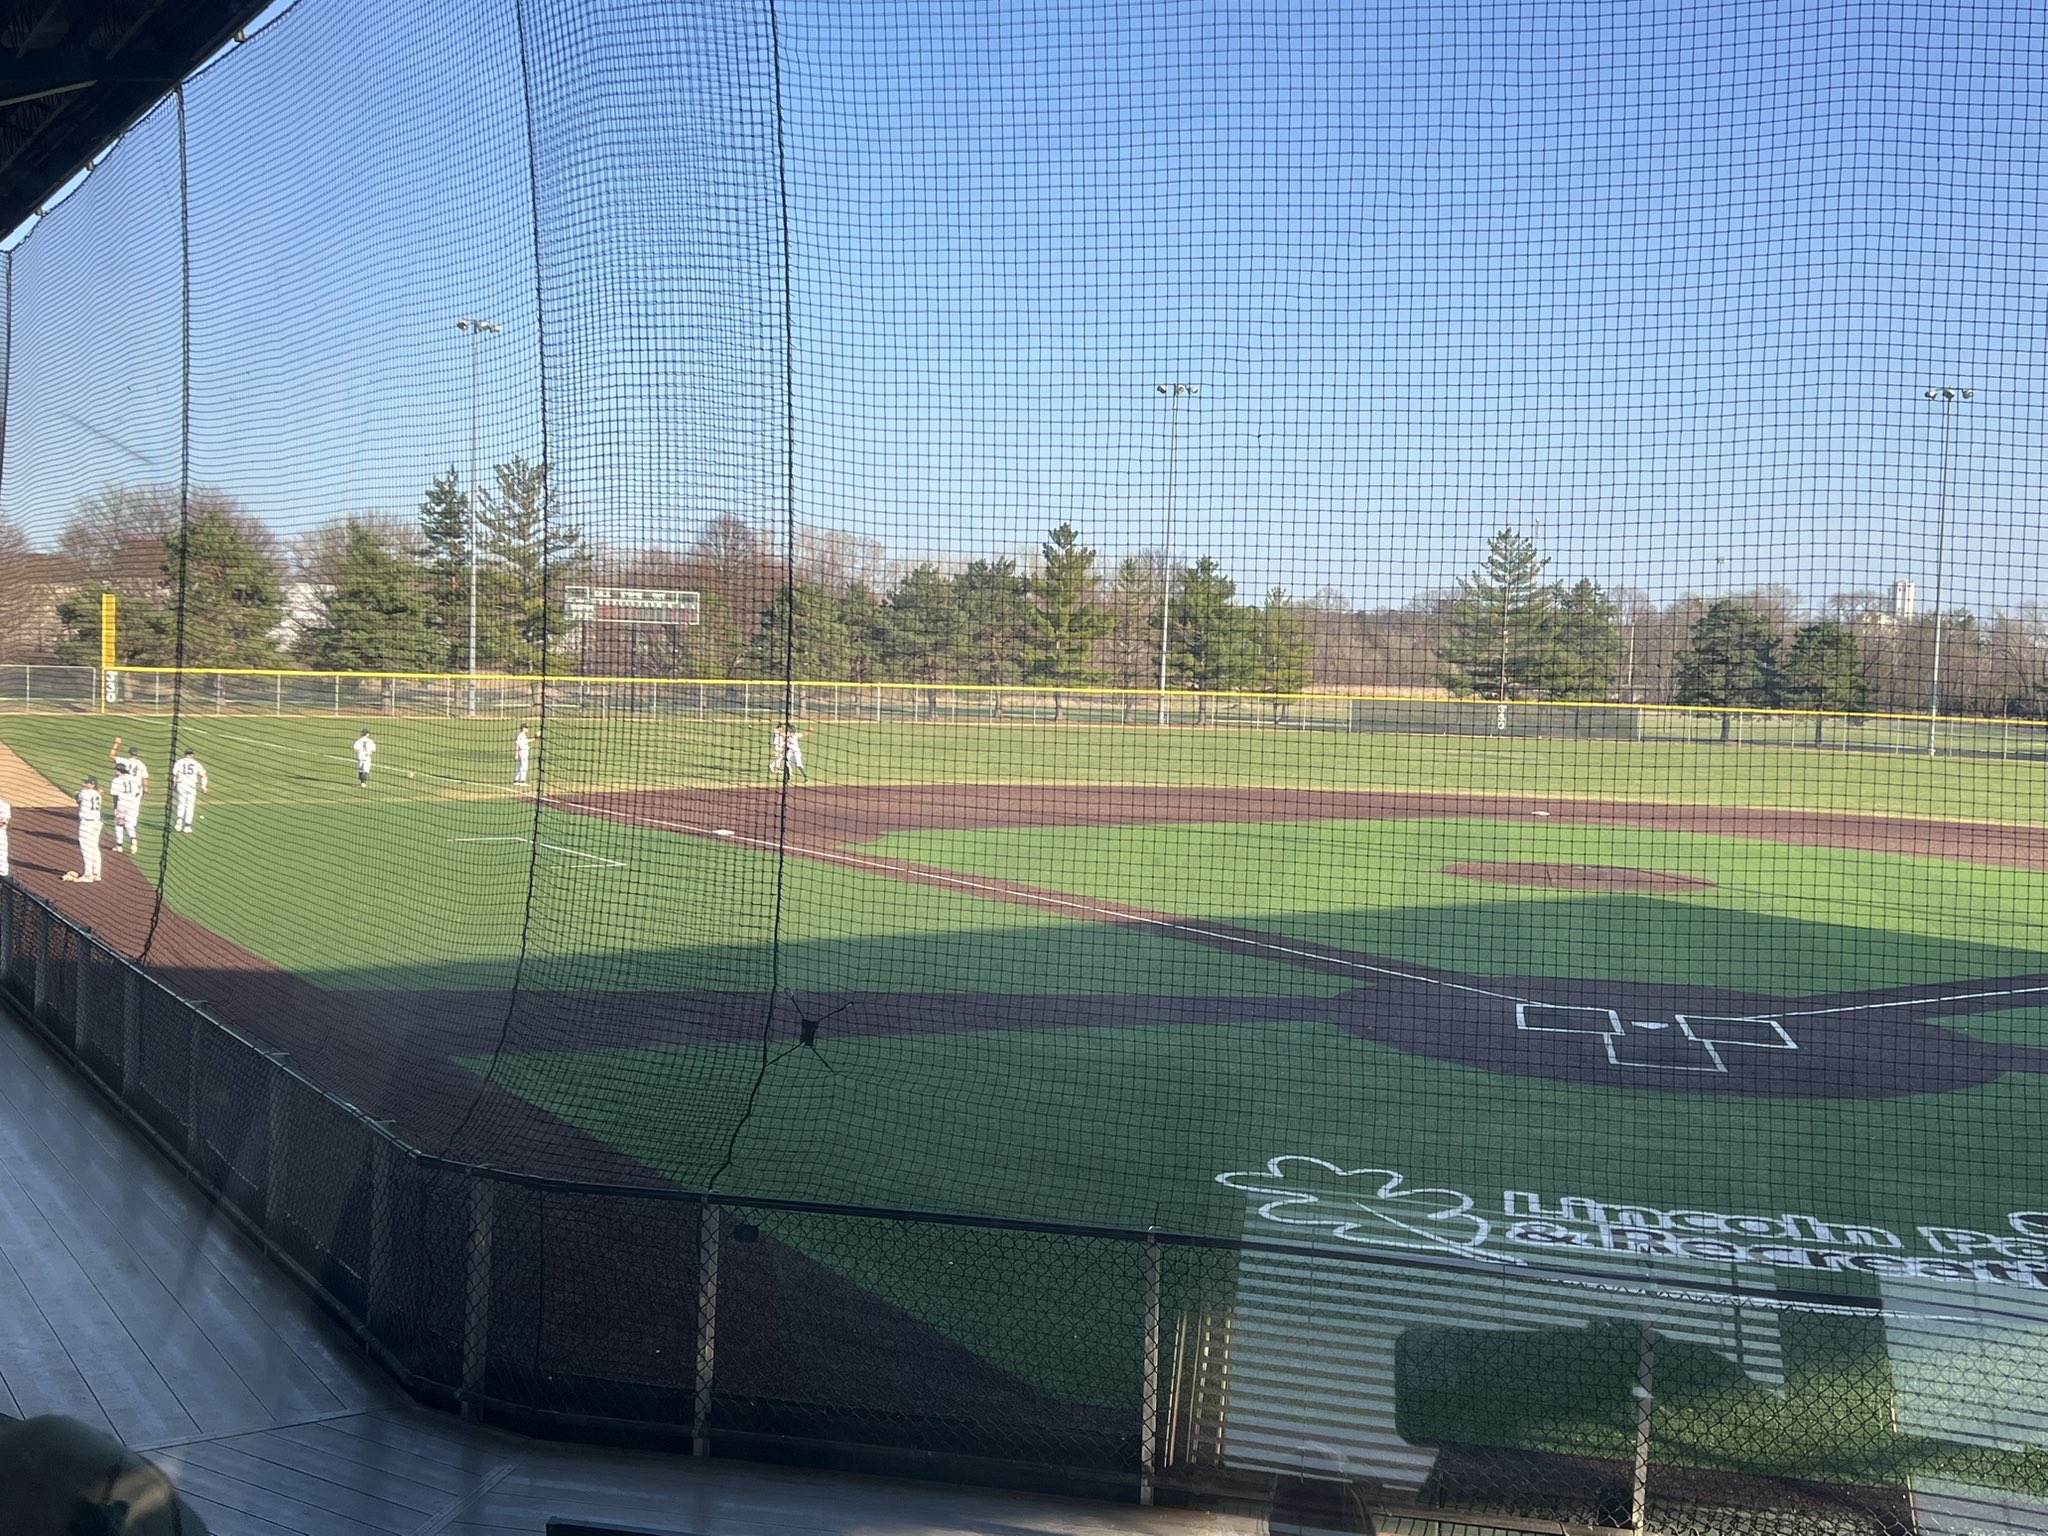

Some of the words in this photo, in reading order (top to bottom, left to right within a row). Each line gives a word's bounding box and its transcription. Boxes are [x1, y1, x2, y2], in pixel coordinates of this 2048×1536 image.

[182, 763, 195, 775] 15
[122, 781, 132, 793] 11
[1503, 1190, 1905, 1249] Lincoln
[1506, 1221, 1596, 1248] &
